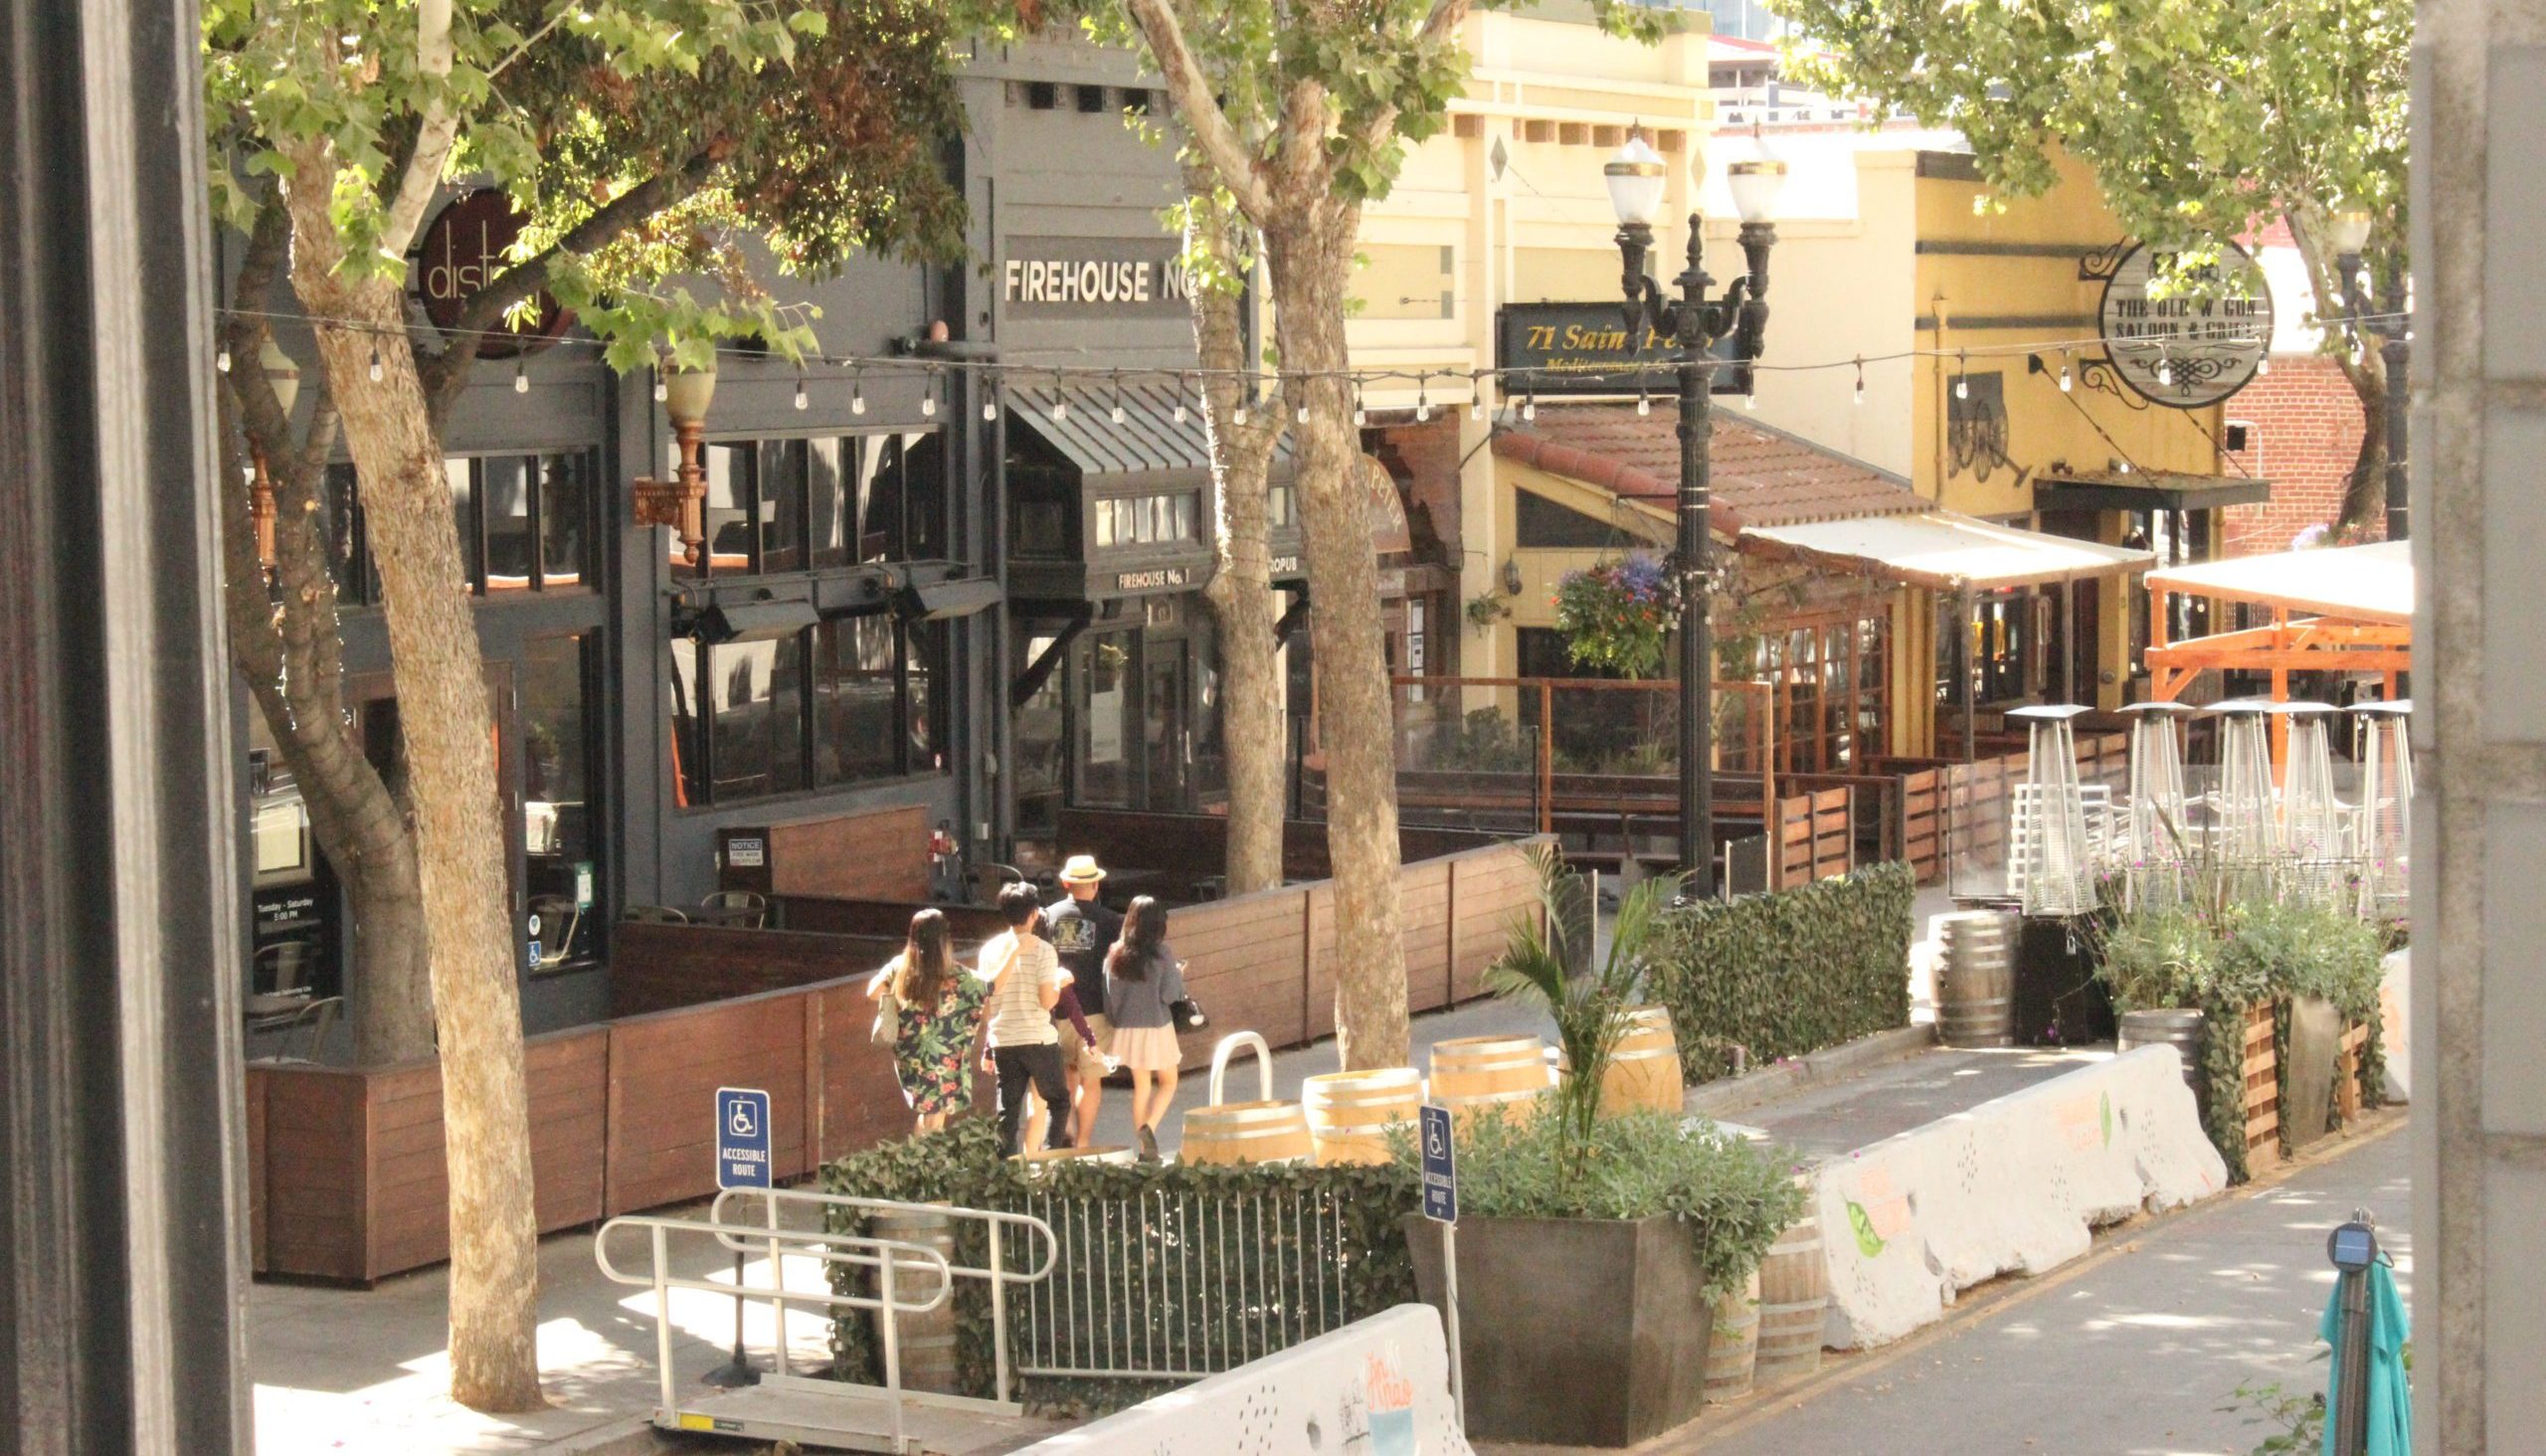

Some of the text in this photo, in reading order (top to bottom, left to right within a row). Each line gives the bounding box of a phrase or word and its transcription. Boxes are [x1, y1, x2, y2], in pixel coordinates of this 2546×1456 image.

[1005, 260, 1150, 302] FIREHOUSE
[2116, 299, 2148, 317] THE
[1527, 325, 1556, 350] 71
[1561, 324, 1627, 350] Sain
[1119, 568, 1189, 589] FIREHOUSE No. 1
[731, 841, 760, 850] NOTICE
[722, 1147, 766, 1163] ACCESSIBLE
[732, 1163, 756, 1178] ROUTE
